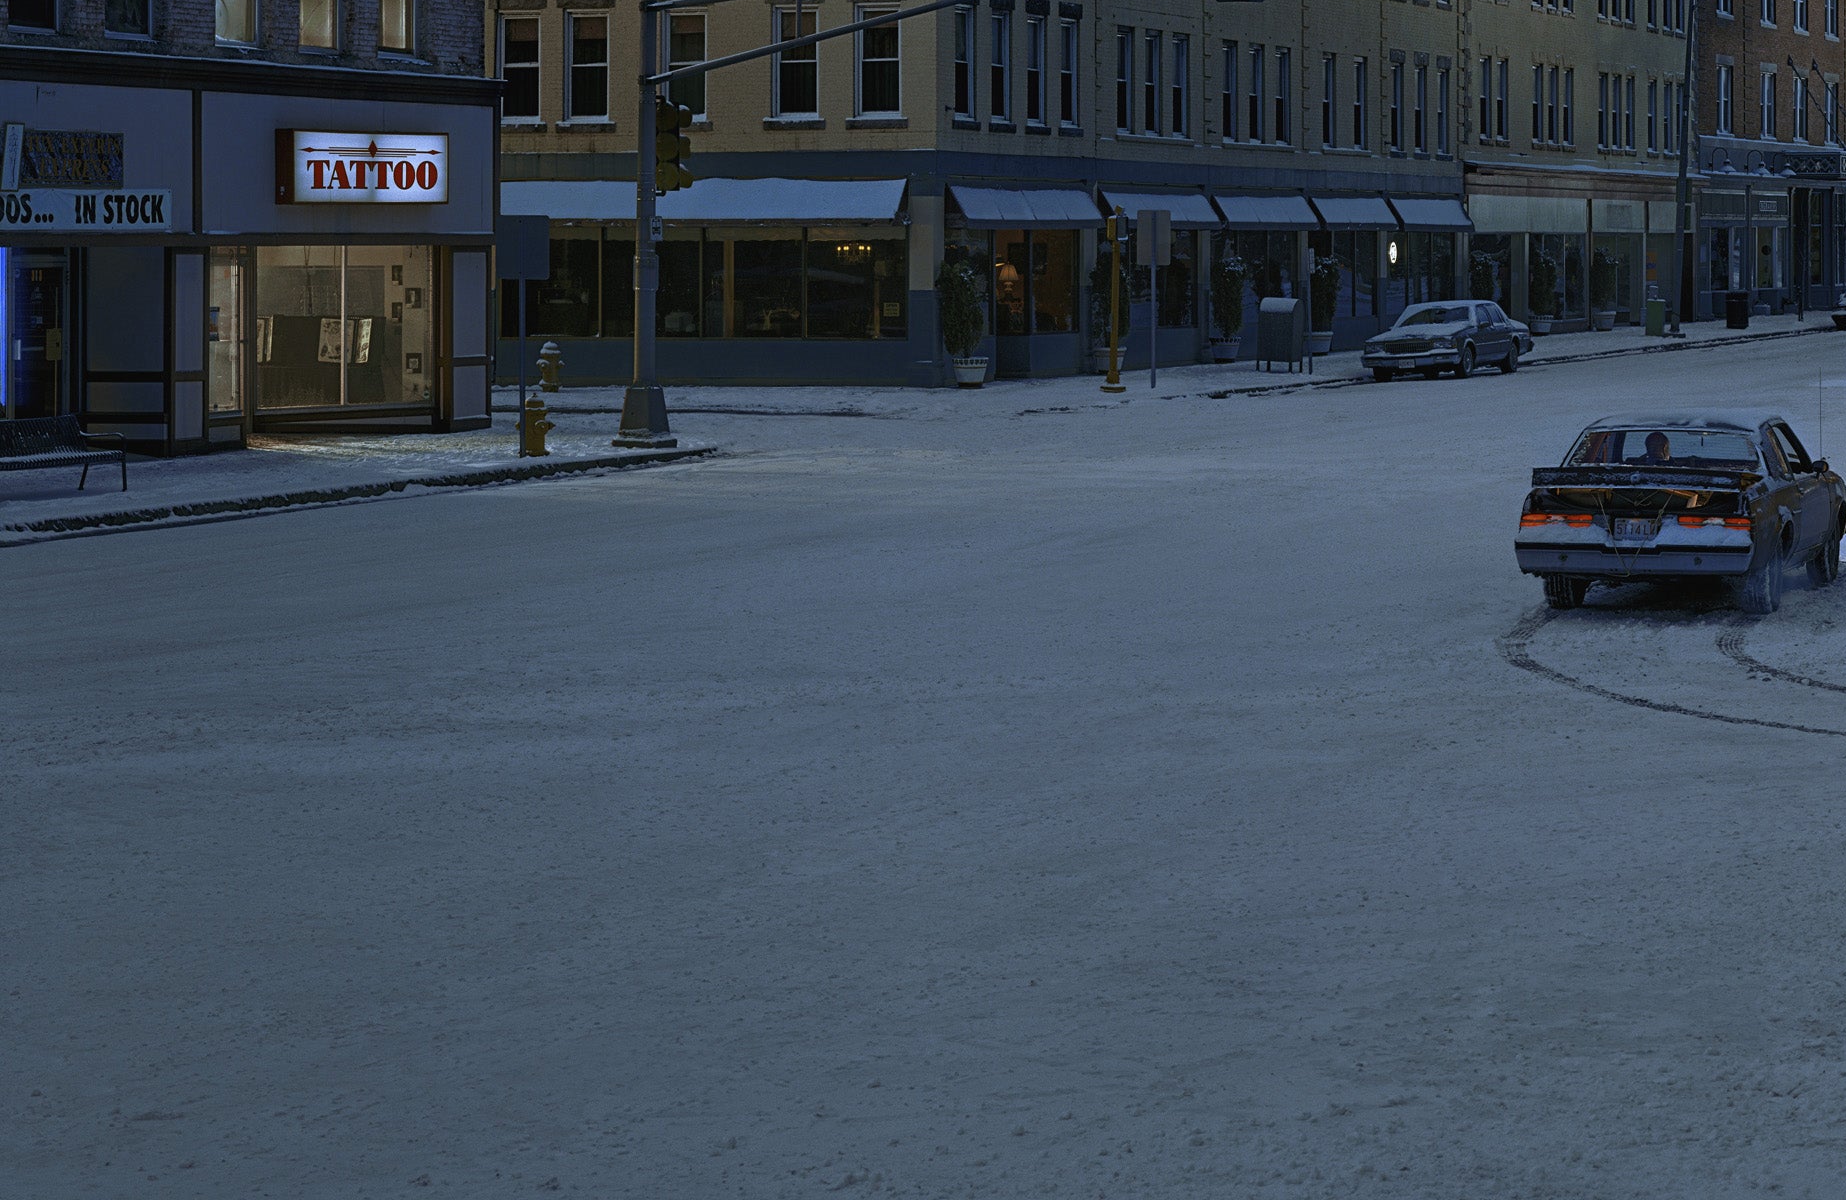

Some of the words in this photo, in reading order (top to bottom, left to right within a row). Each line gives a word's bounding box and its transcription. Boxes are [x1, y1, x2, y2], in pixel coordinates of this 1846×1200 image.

[61, 137, 120, 155] EXPERTS
[38, 158, 111, 178] EXPRESS
[307, 160, 438, 190] TATTOO
[0, 193, 54, 224] OS...
[75, 195, 96, 224] IN
[103, 194, 164, 225] STOCK
